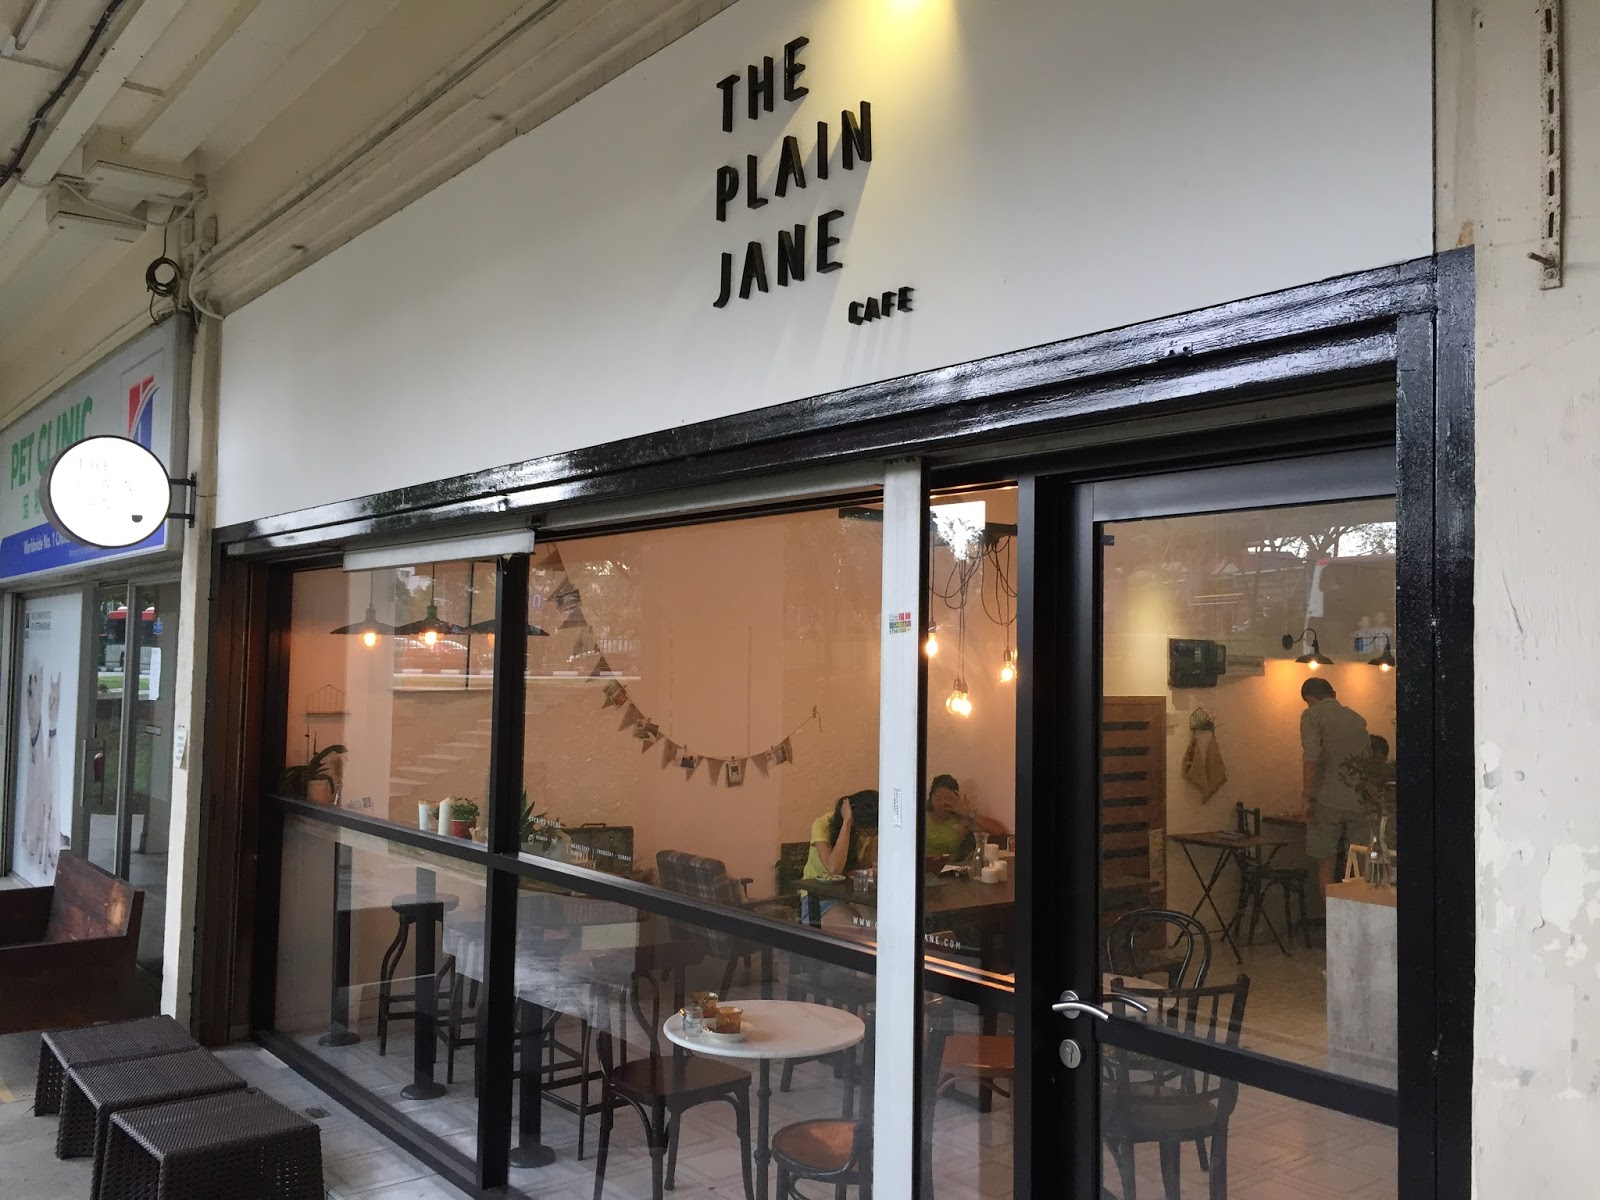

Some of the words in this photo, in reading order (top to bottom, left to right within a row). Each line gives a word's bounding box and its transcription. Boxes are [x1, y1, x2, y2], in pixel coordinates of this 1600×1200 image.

[716, 36, 810, 133] THE
[716, 100, 872, 222] PLAIN
[713, 209, 845, 309] JANE
[848, 286, 915, 326] CAFE
[10, 432, 35, 491] PET
